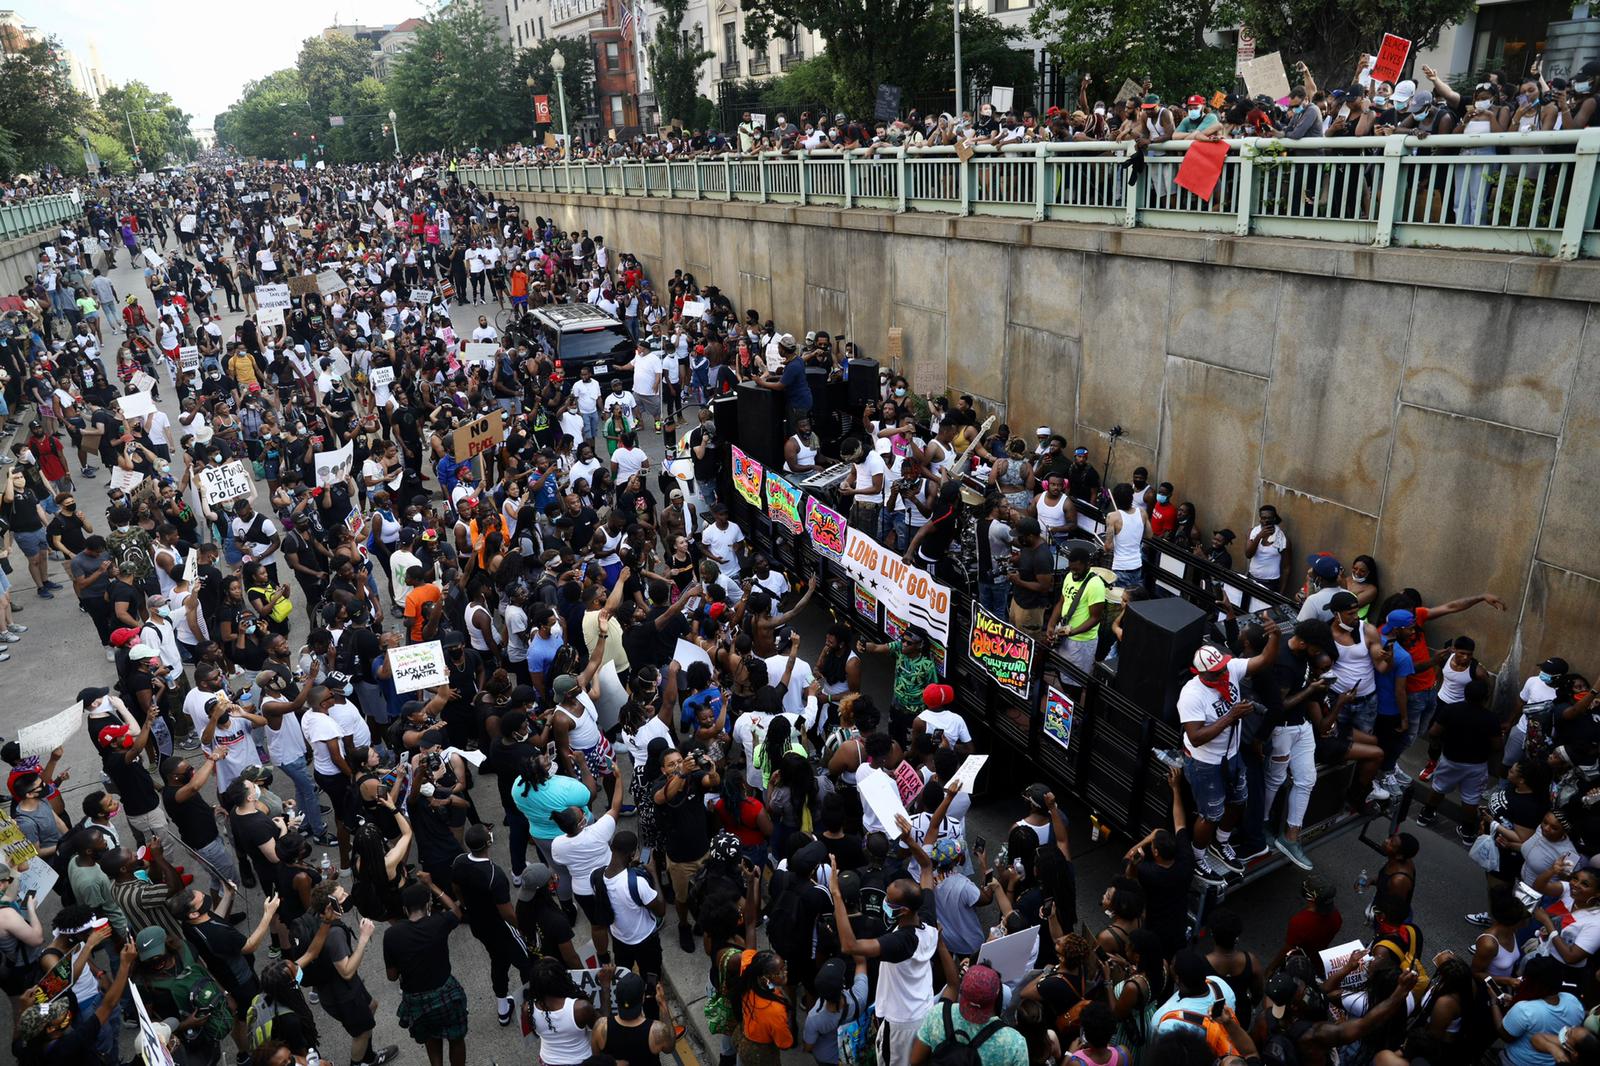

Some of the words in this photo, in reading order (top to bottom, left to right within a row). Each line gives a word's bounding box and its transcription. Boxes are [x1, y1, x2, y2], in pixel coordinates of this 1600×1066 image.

[535, 102, 548, 114] 16
[470, 419, 489, 438] NO
[468, 436, 494, 457] PEACE
[206, 463, 244, 482] DEFUND
[209, 483, 248, 503] POLICE
[214, 478, 235, 491] THE
[847, 535, 878, 571] LONG
[880, 555, 909, 589] LIVE
[976, 612, 1003, 635] INVEST
[1004, 627, 1015, 640] IN
[395, 666, 418, 679] BLACK
[418, 662, 436, 672] LIVES
[411, 669, 439, 681] MATTER
[898, 763, 922, 793] BLACK
